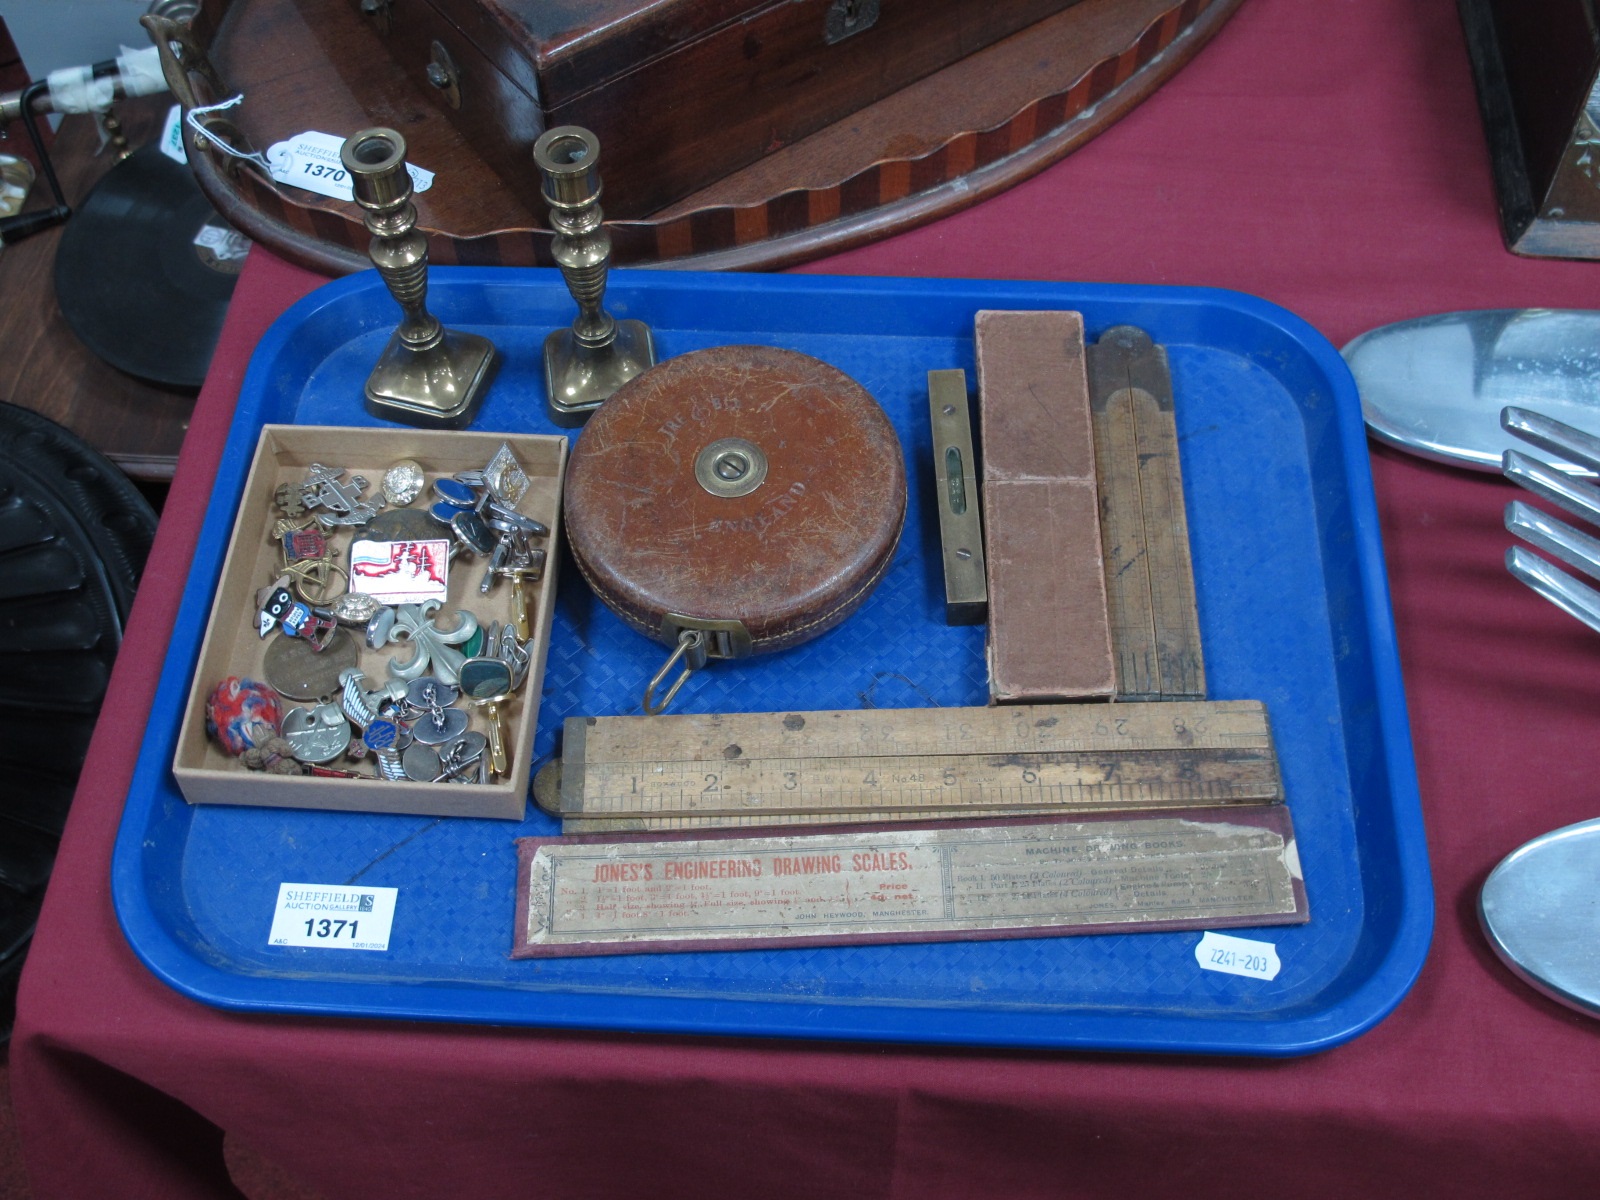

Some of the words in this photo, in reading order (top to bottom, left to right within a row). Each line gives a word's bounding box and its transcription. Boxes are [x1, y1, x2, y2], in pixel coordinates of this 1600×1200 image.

[304, 162, 346, 182] 1370
[630, 776, 637, 794] 1
[703, 773, 720, 793] 2
[783, 771, 798, 791] 3
[862, 769, 878, 788] 4
[942, 767, 957, 787] 5
[1025, 845, 1078, 856] MACHINE
[592, 862, 653, 884] JONES'S
[664, 858, 763, 881] ENGINEERING
[773, 854, 842, 877] DRAWING
[852, 851, 914, 873] SCALES.
[879, 883, 908, 891] Price
[285, 890, 360, 903] SHEFFIELD
[646, 901, 686, 910] showing
[750, 898, 791, 906] showing
[304, 917, 359, 939] 1371
